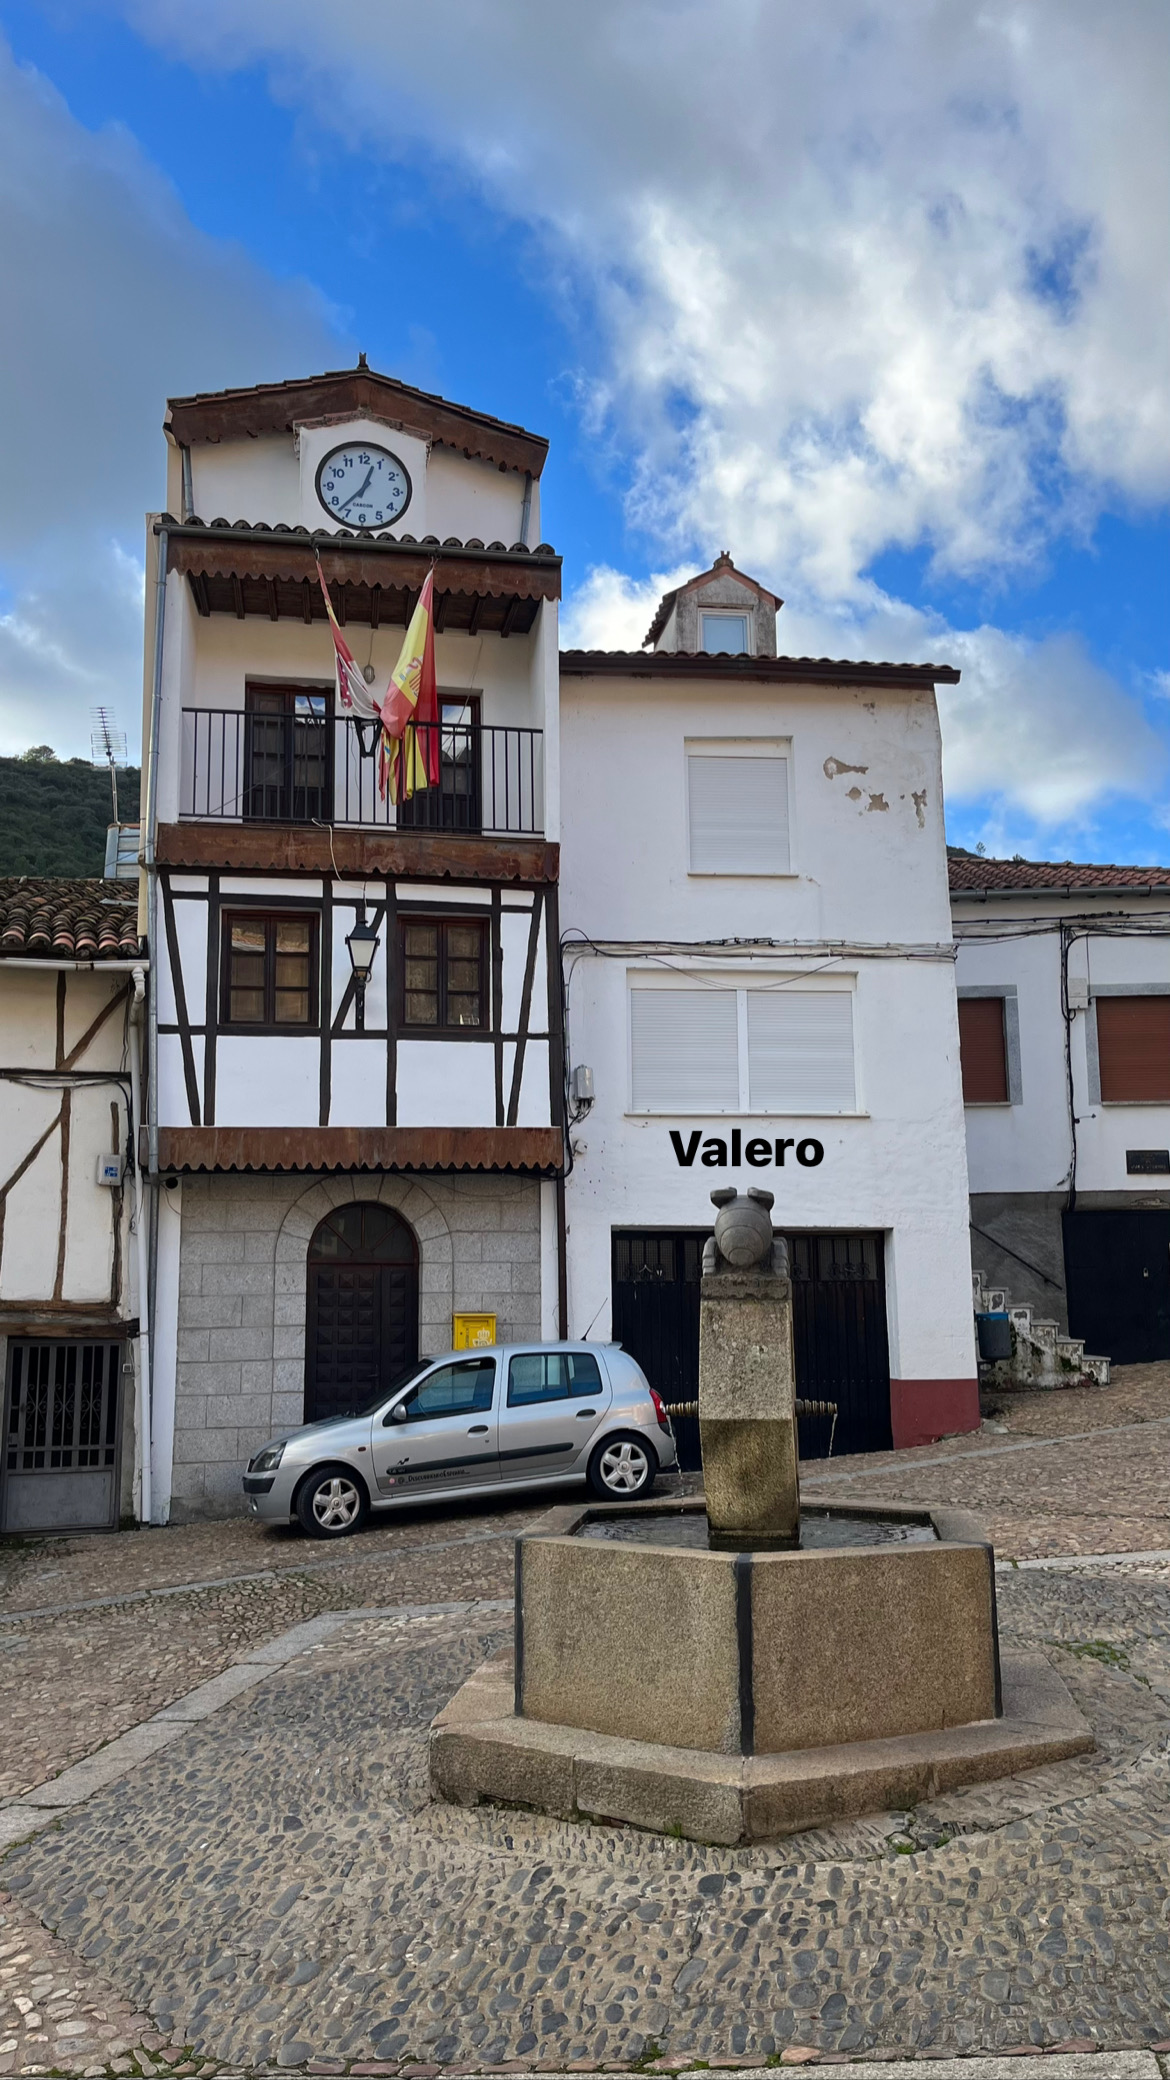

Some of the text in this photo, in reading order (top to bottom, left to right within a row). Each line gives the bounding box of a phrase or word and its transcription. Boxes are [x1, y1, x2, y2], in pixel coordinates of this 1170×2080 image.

[343, 458, 353, 468] 11
[358, 455, 371, 465] 12
[376, 461, 382, 470] 1
[331, 468, 345, 478] 10
[388, 472, 396, 481] 2
[326, 481, 335, 491] 9
[392, 487, 400, 497] 3
[331, 496, 339, 506] 8
[386, 502, 394, 512] 4
[344, 509, 352, 518] 7
[358, 513, 366, 523] 6
[375, 511, 383, 521] 5
